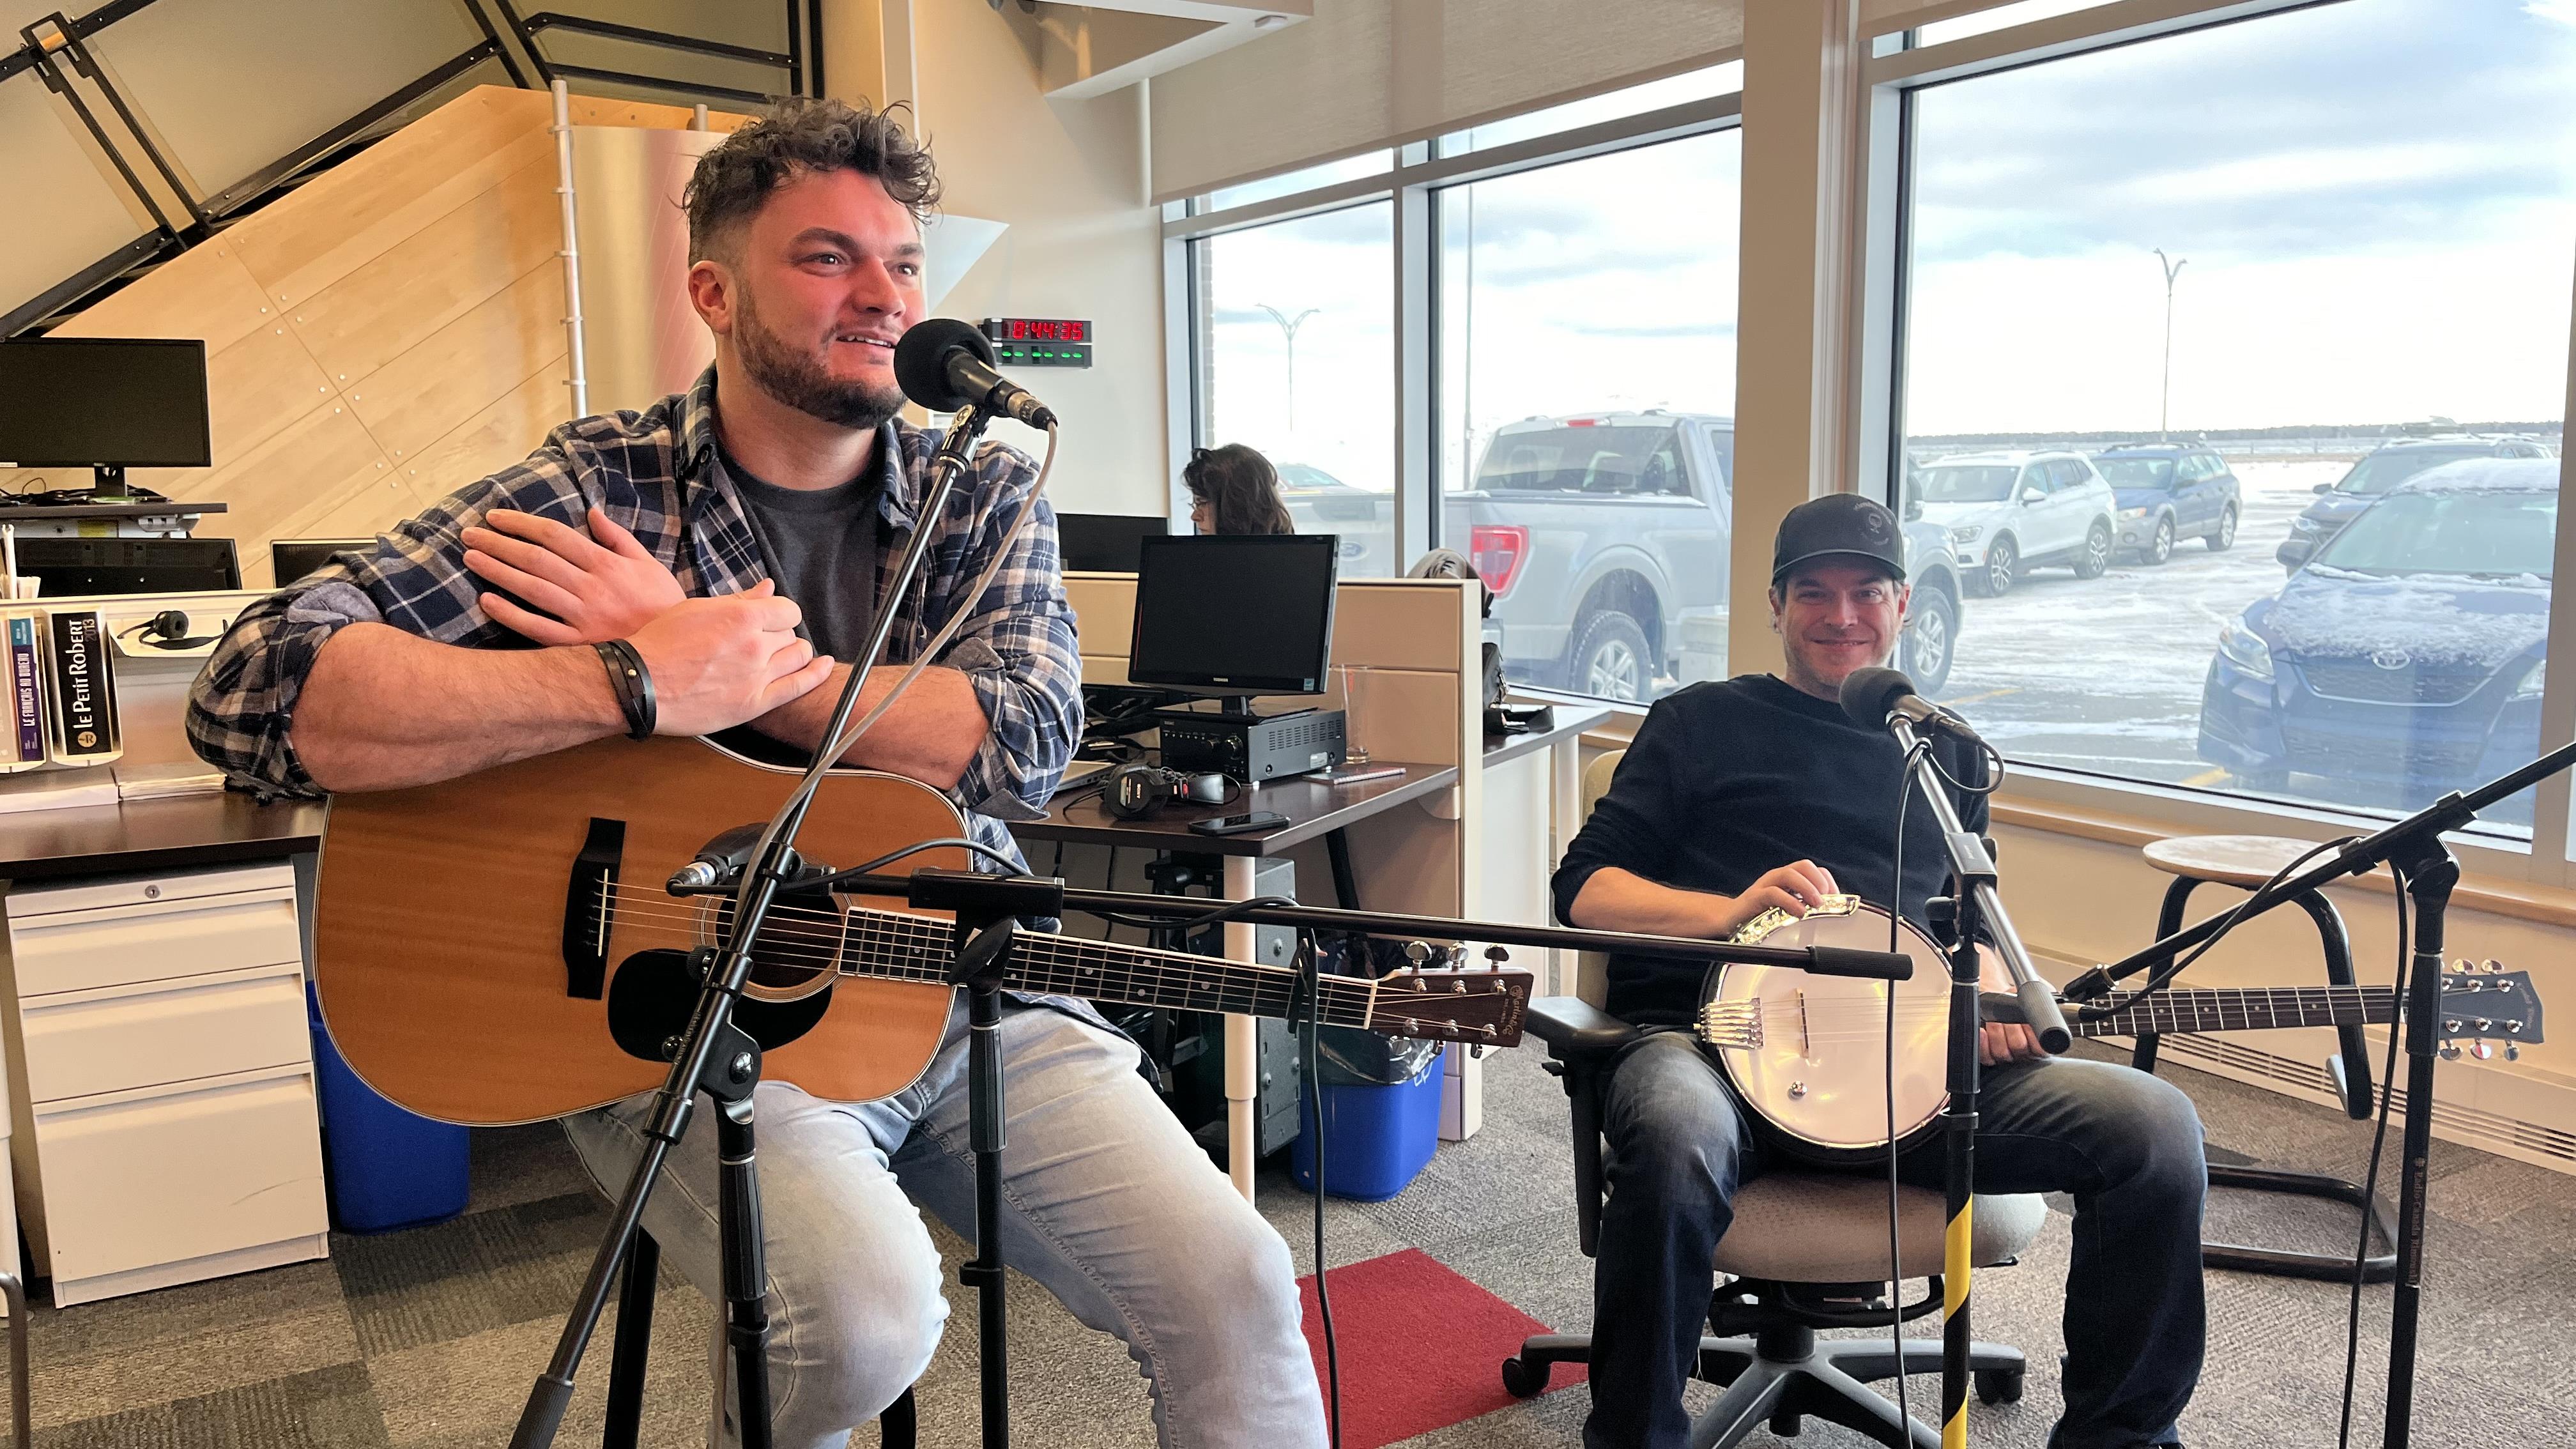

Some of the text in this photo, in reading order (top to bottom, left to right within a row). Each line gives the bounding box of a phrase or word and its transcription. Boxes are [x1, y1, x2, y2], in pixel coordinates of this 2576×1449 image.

[82, 618, 96, 642] 2013
[20, 678, 31, 687] AU
[20, 688, 34, 717] FRANÇAIS
[23, 717, 35, 726] LE
